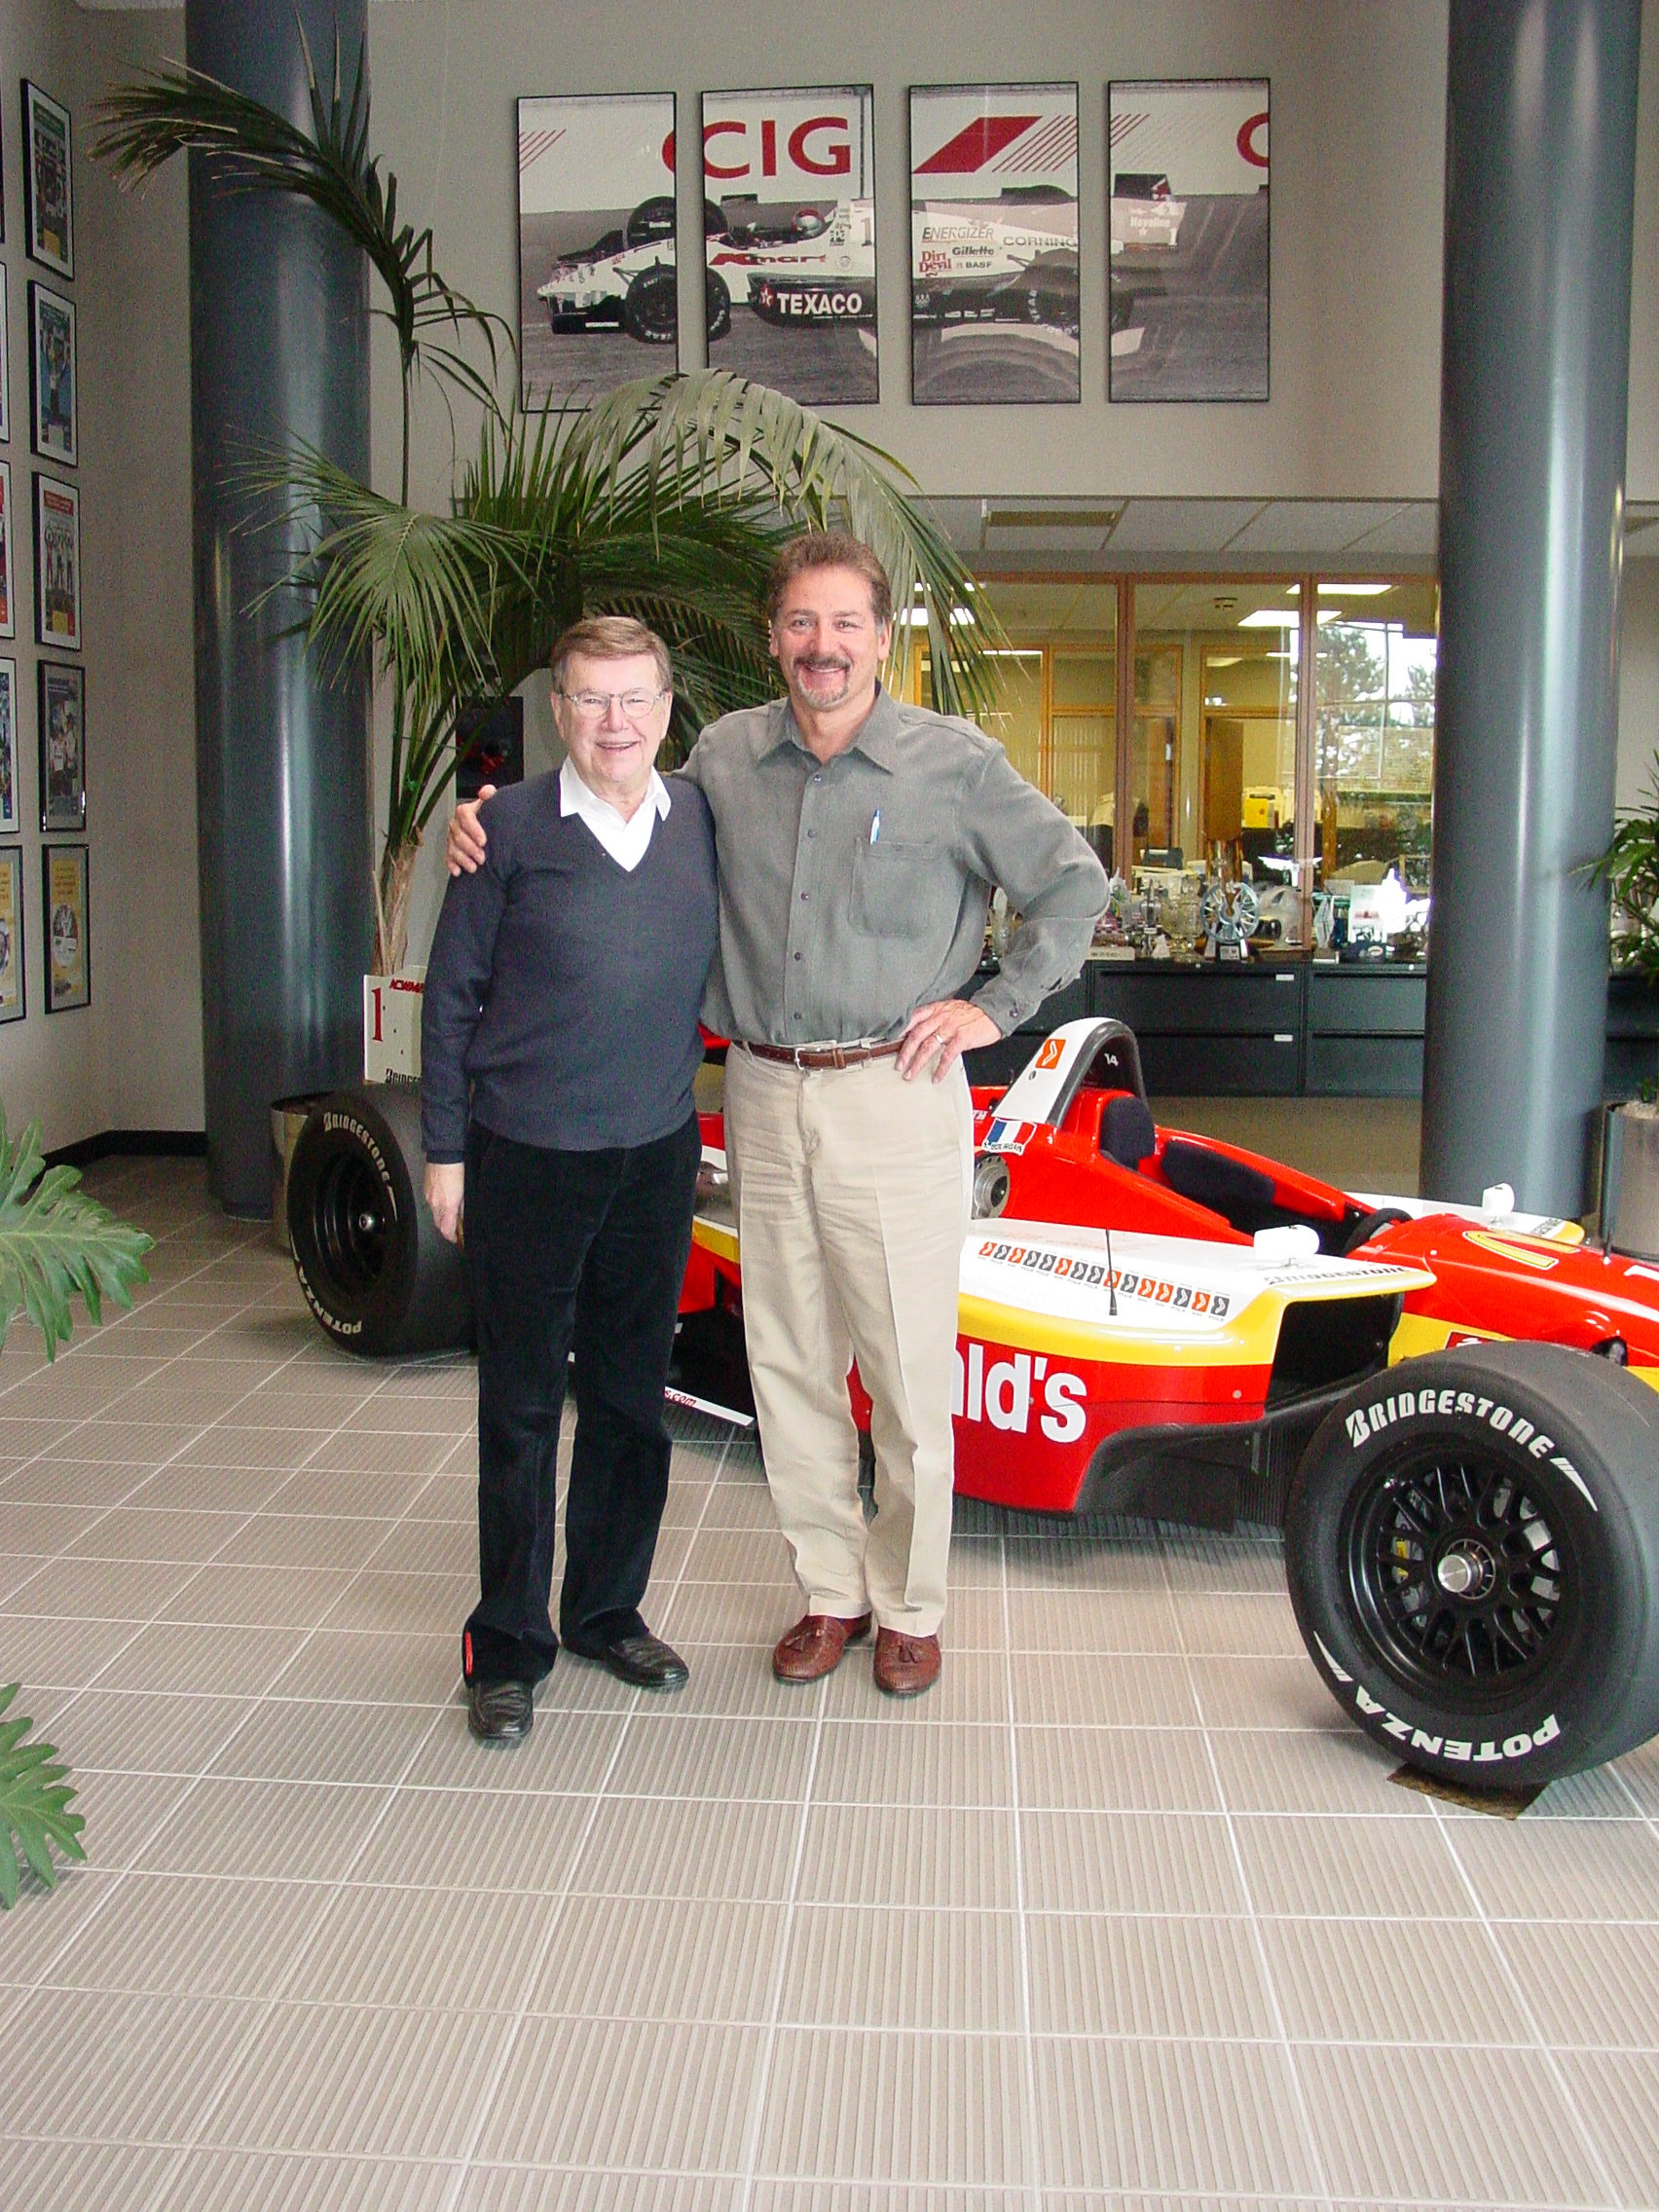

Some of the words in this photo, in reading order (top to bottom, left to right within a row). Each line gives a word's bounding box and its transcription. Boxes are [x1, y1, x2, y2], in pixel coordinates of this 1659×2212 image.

[921, 226, 995, 240] ENERGIZER
[951, 245, 995, 256] Gillette
[919, 259, 952, 274] Devil
[776, 293, 863, 315] TEXACO
[371, 987, 384, 1043] 1
[1104, 1052, 1119, 1066] 14
[323, 1112, 390, 1188] BRIDGESTONE
[1345, 1389, 1556, 1449] BRIDGESTONE
[1355, 1685, 1561, 1761] POTENZA
